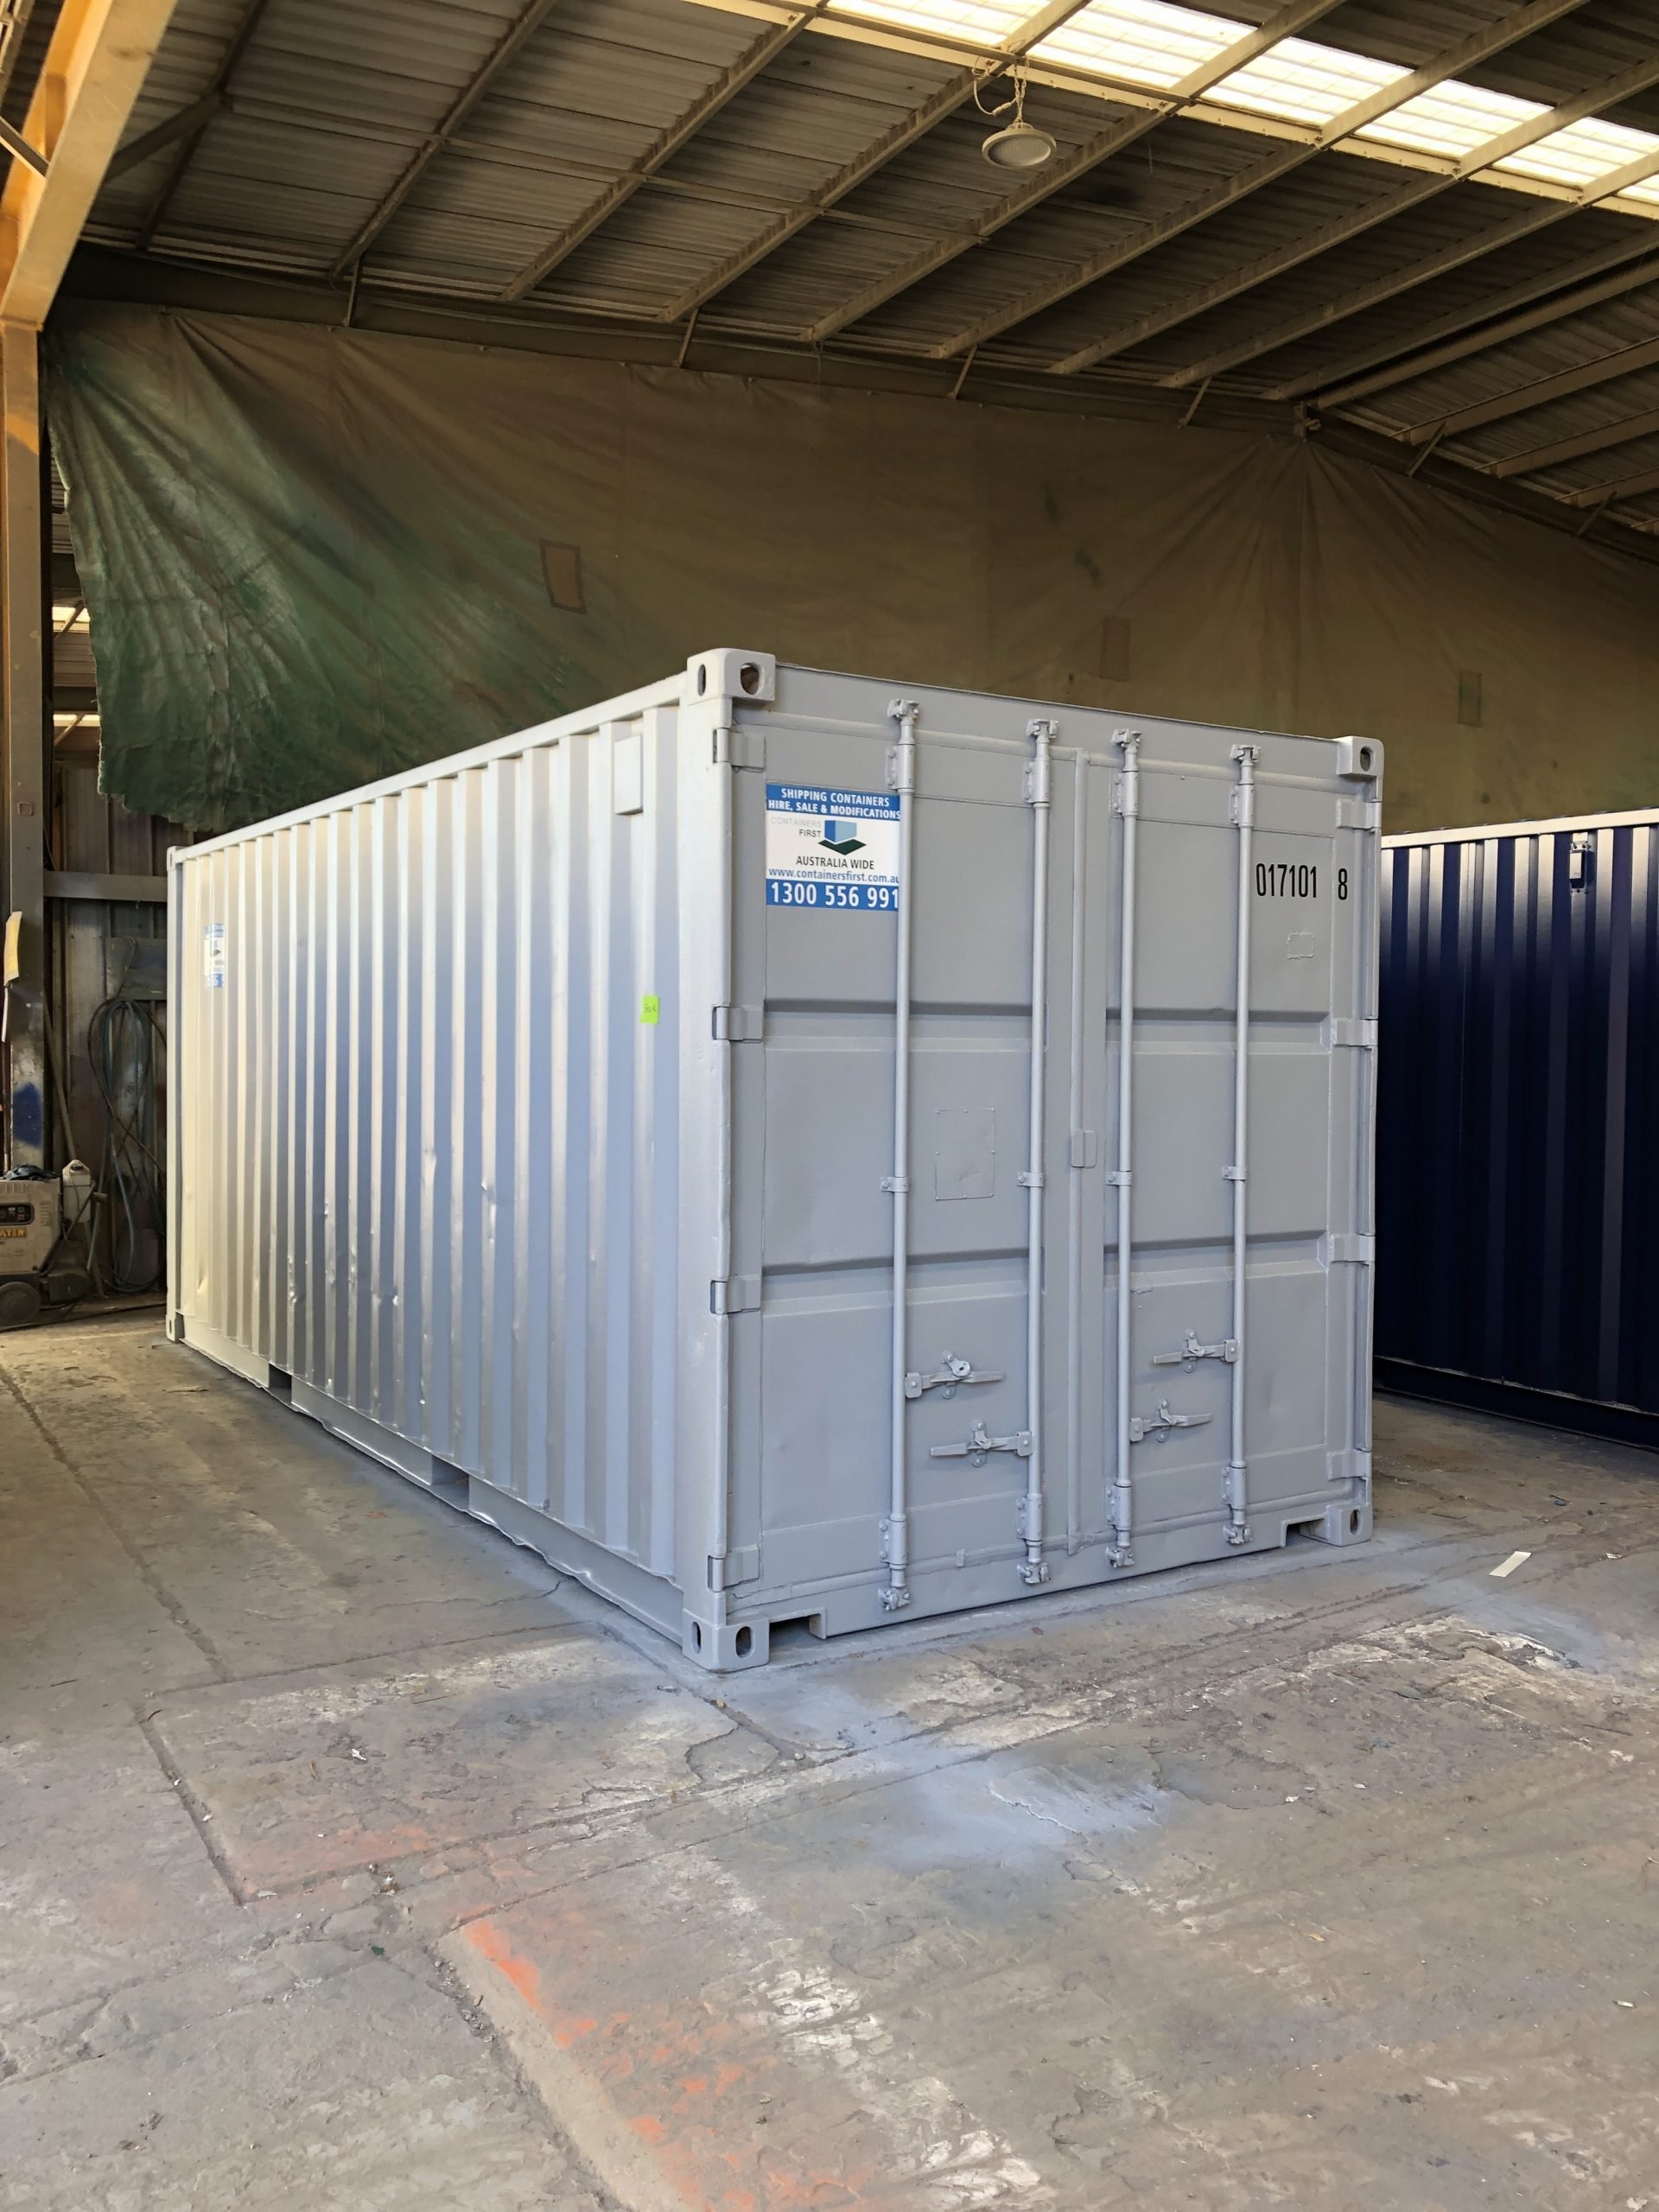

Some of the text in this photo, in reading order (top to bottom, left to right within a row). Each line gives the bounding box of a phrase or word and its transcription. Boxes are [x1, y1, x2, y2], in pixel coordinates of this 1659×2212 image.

[781, 788, 890, 807] SHIPPING CONTAINERS
[768, 800, 900, 820] HIRE, SALE & MODIFICATIONS
[771, 817, 822, 829] CONTAINERS
[798, 829, 822, 838] FIRST
[796, 855, 874, 870] AUSTRALIA WIDE
[1255, 862, 1348, 900] 017101 8
[771, 881, 899, 909] 1300 556 991
